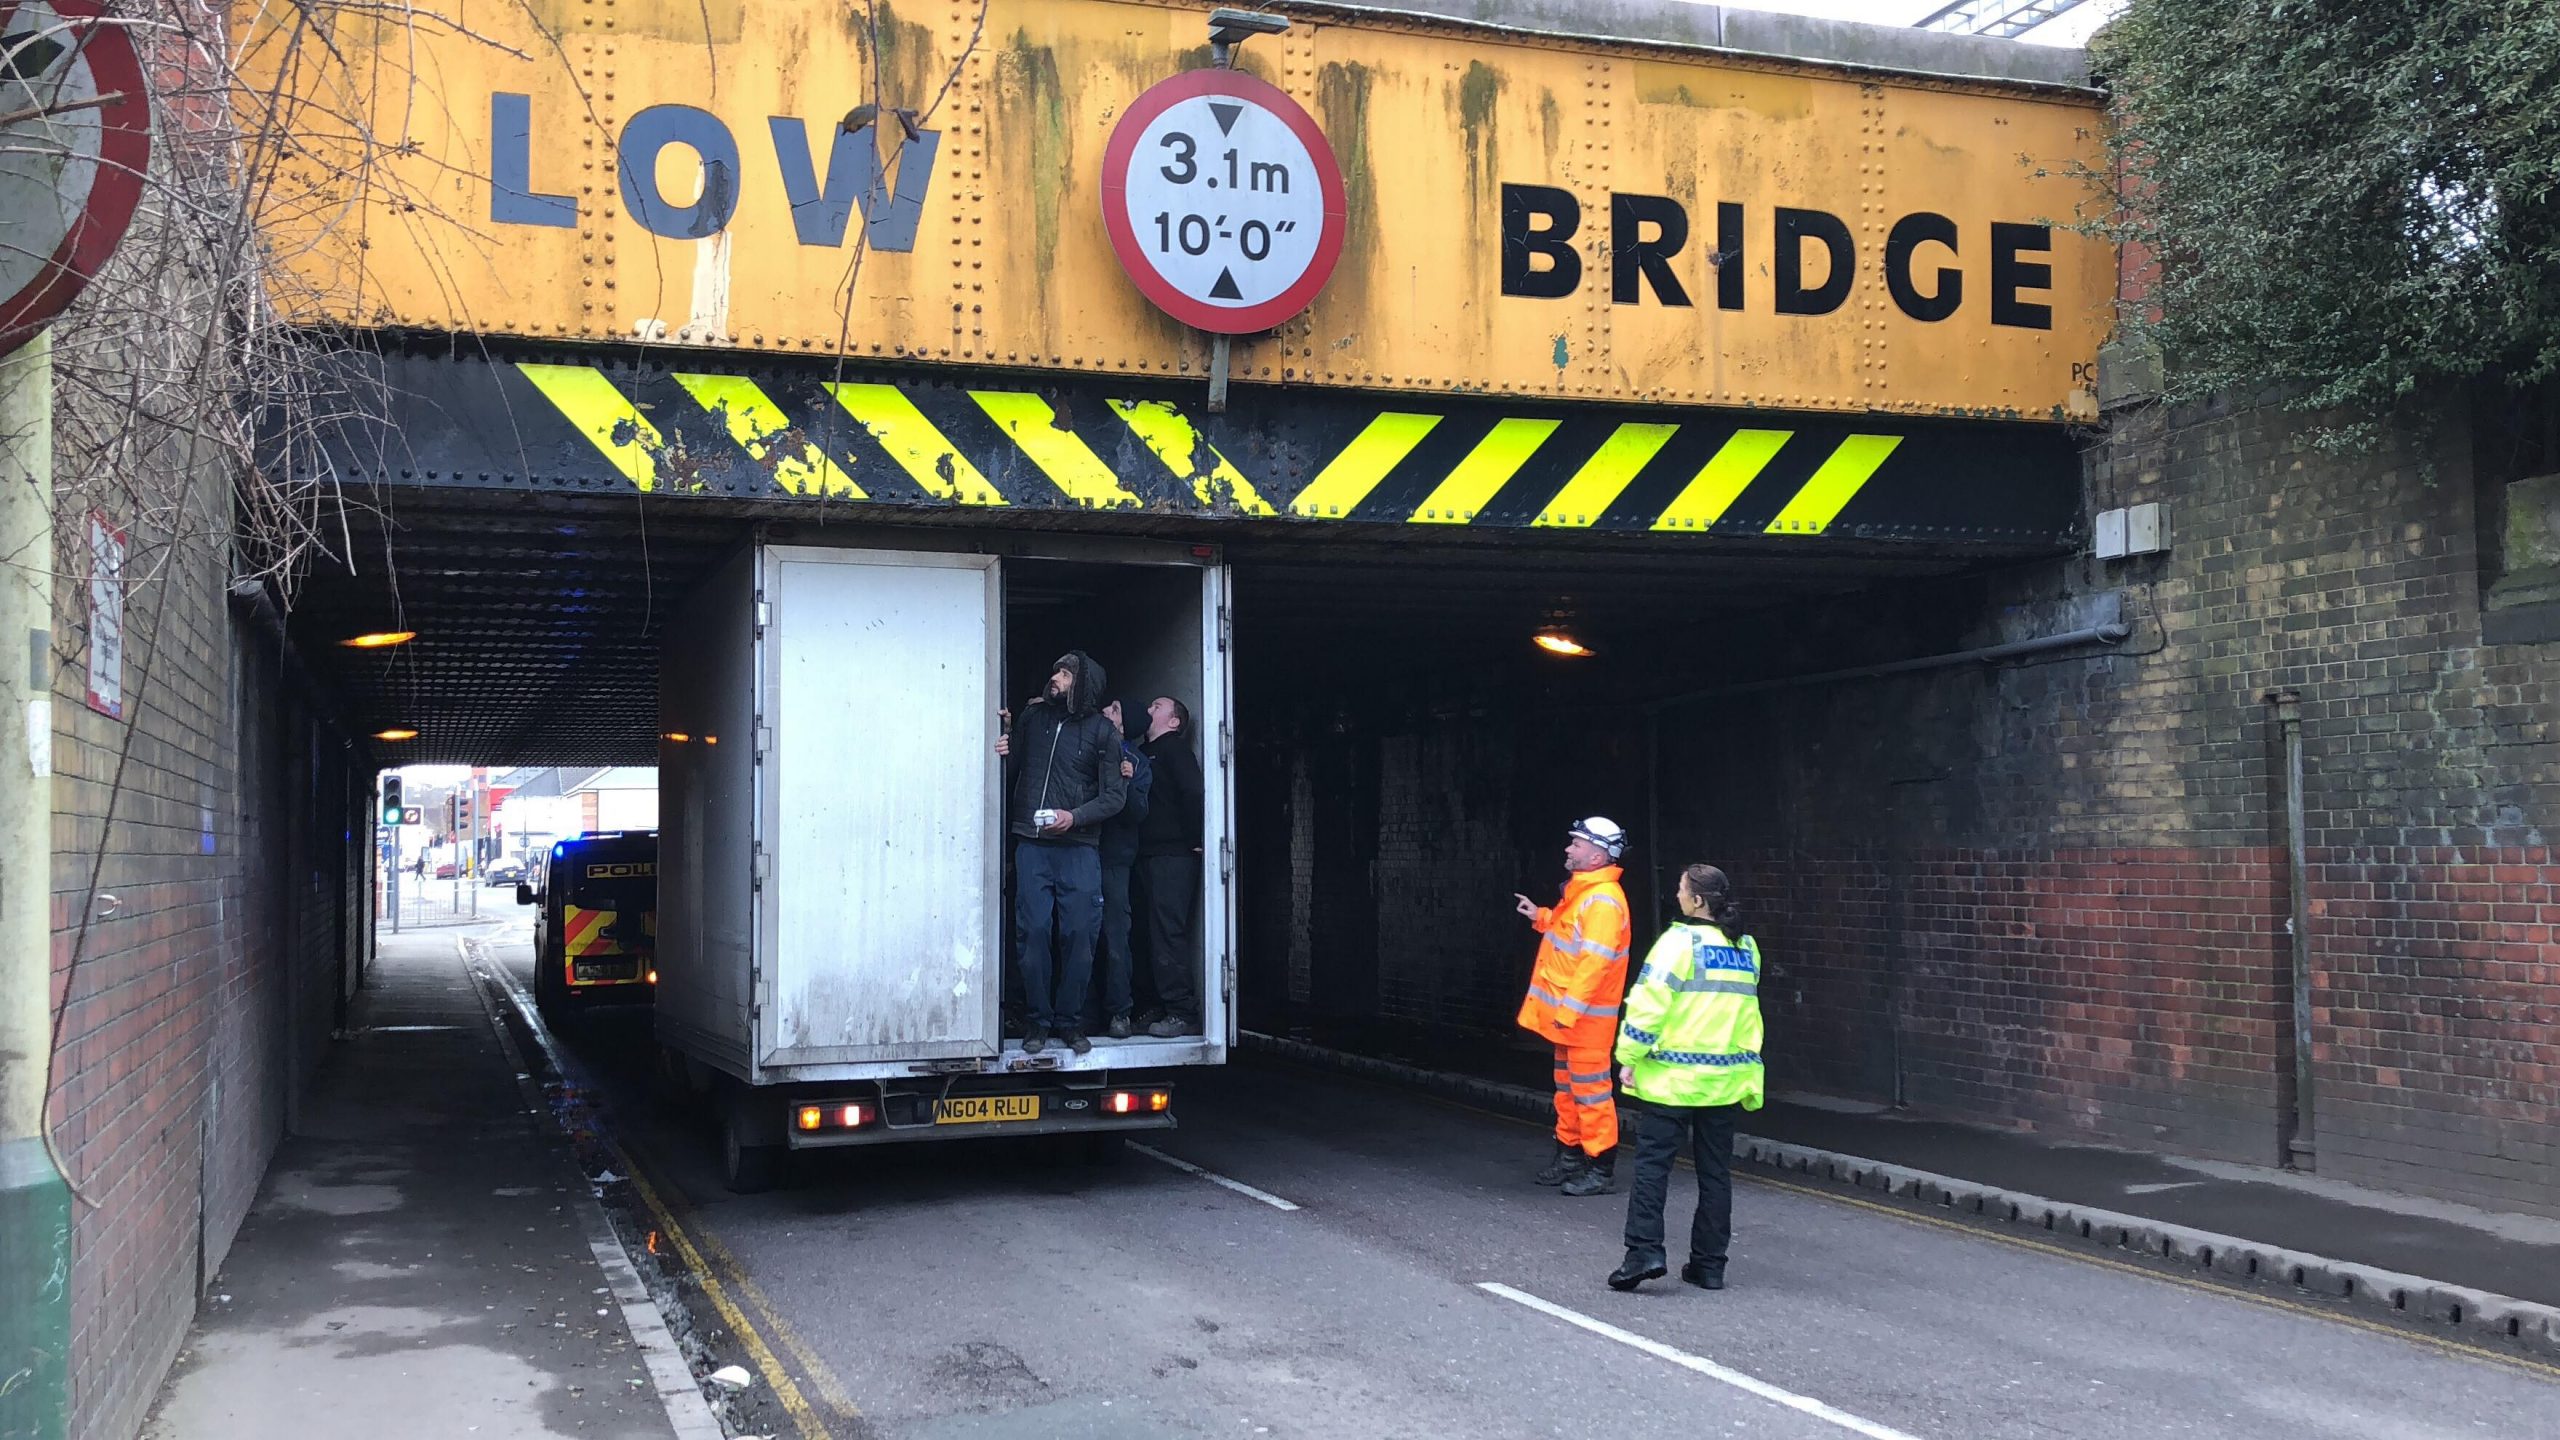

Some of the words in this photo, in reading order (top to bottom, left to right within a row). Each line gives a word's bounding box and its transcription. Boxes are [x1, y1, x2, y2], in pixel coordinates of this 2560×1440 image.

[491, 91, 941, 253] LOW
[1159, 131, 1290, 194] 3.1m
[1500, 181, 2053, 331] BRIDGE
[1705, 948, 1753, 969] POLICE
[940, 1101, 989, 1119] NG04
[994, 1098, 1030, 1116] RLU
